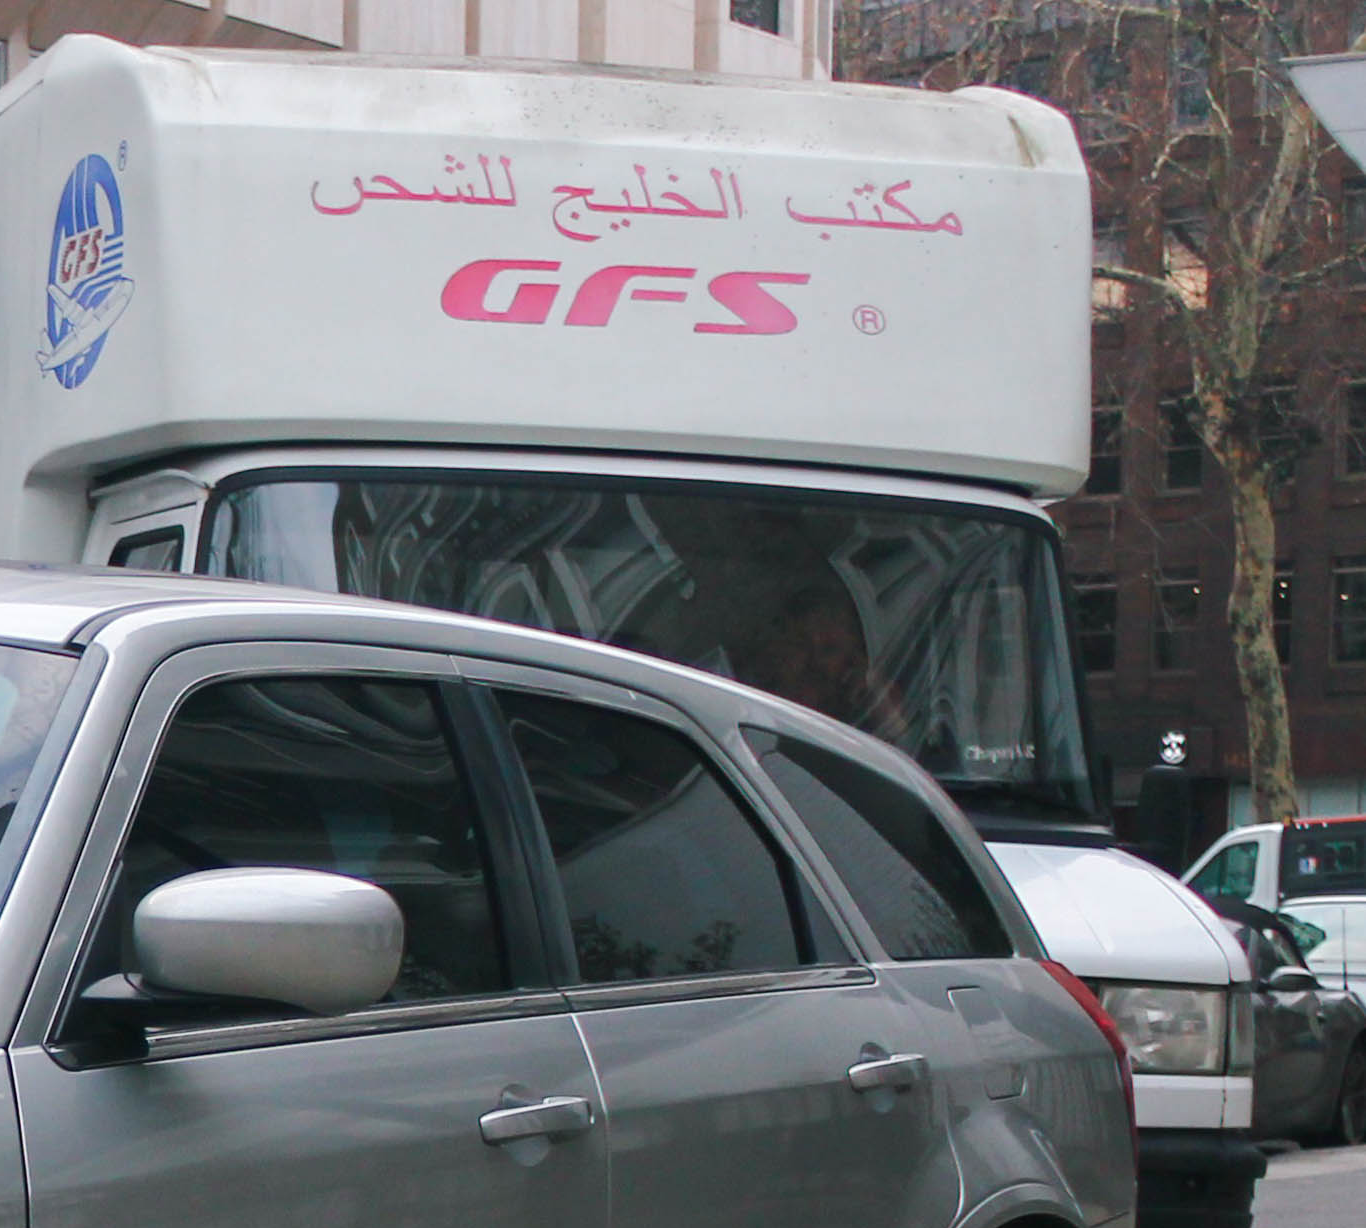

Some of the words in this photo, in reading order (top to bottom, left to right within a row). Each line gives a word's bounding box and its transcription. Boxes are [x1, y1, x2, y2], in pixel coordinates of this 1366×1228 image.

[552, 162, 744, 243] الخليج
[785, 179, 964, 242] مكتب
[440, 258, 812, 336] GFS
